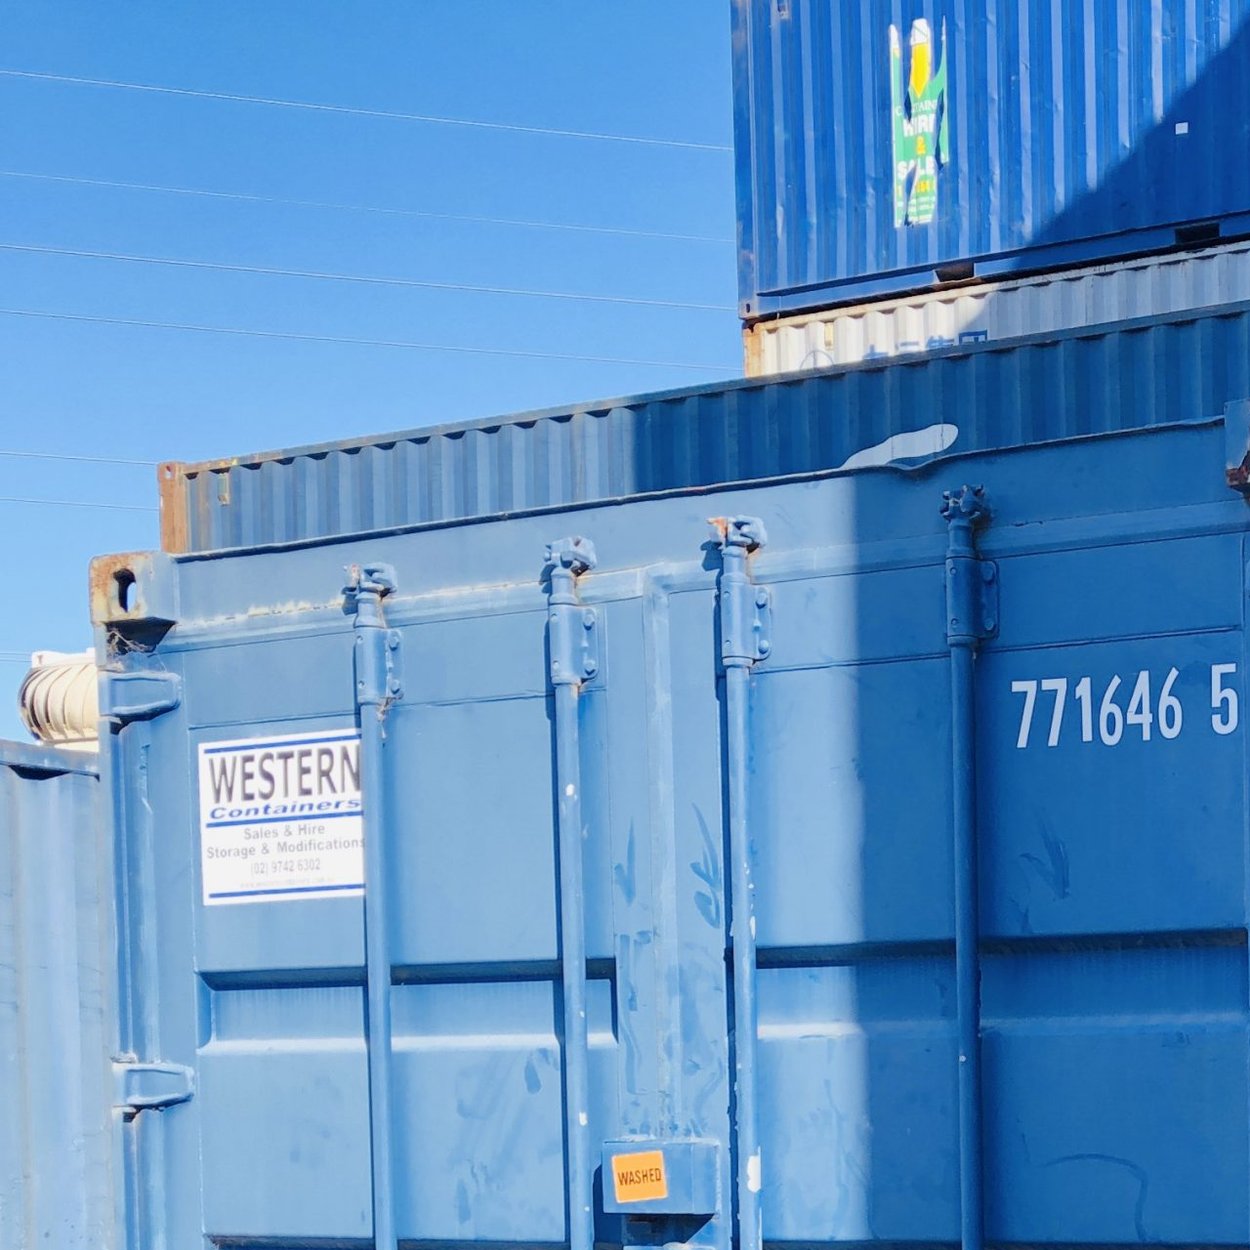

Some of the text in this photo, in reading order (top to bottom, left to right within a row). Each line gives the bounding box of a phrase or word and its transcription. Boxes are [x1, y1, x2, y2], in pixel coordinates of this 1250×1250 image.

[1011, 663, 1239, 749] 771646 5
[208, 744, 361, 804] WESTERN
[210, 800, 361, 819] Containers
[243, 824, 326, 840] Sales & Hire
[206, 846, 256, 860] Storage
[261, 842, 270, 855] &
[251, 858, 321, 877] (02) 9742 6302
[617, 1168, 662, 1186] WASHED
